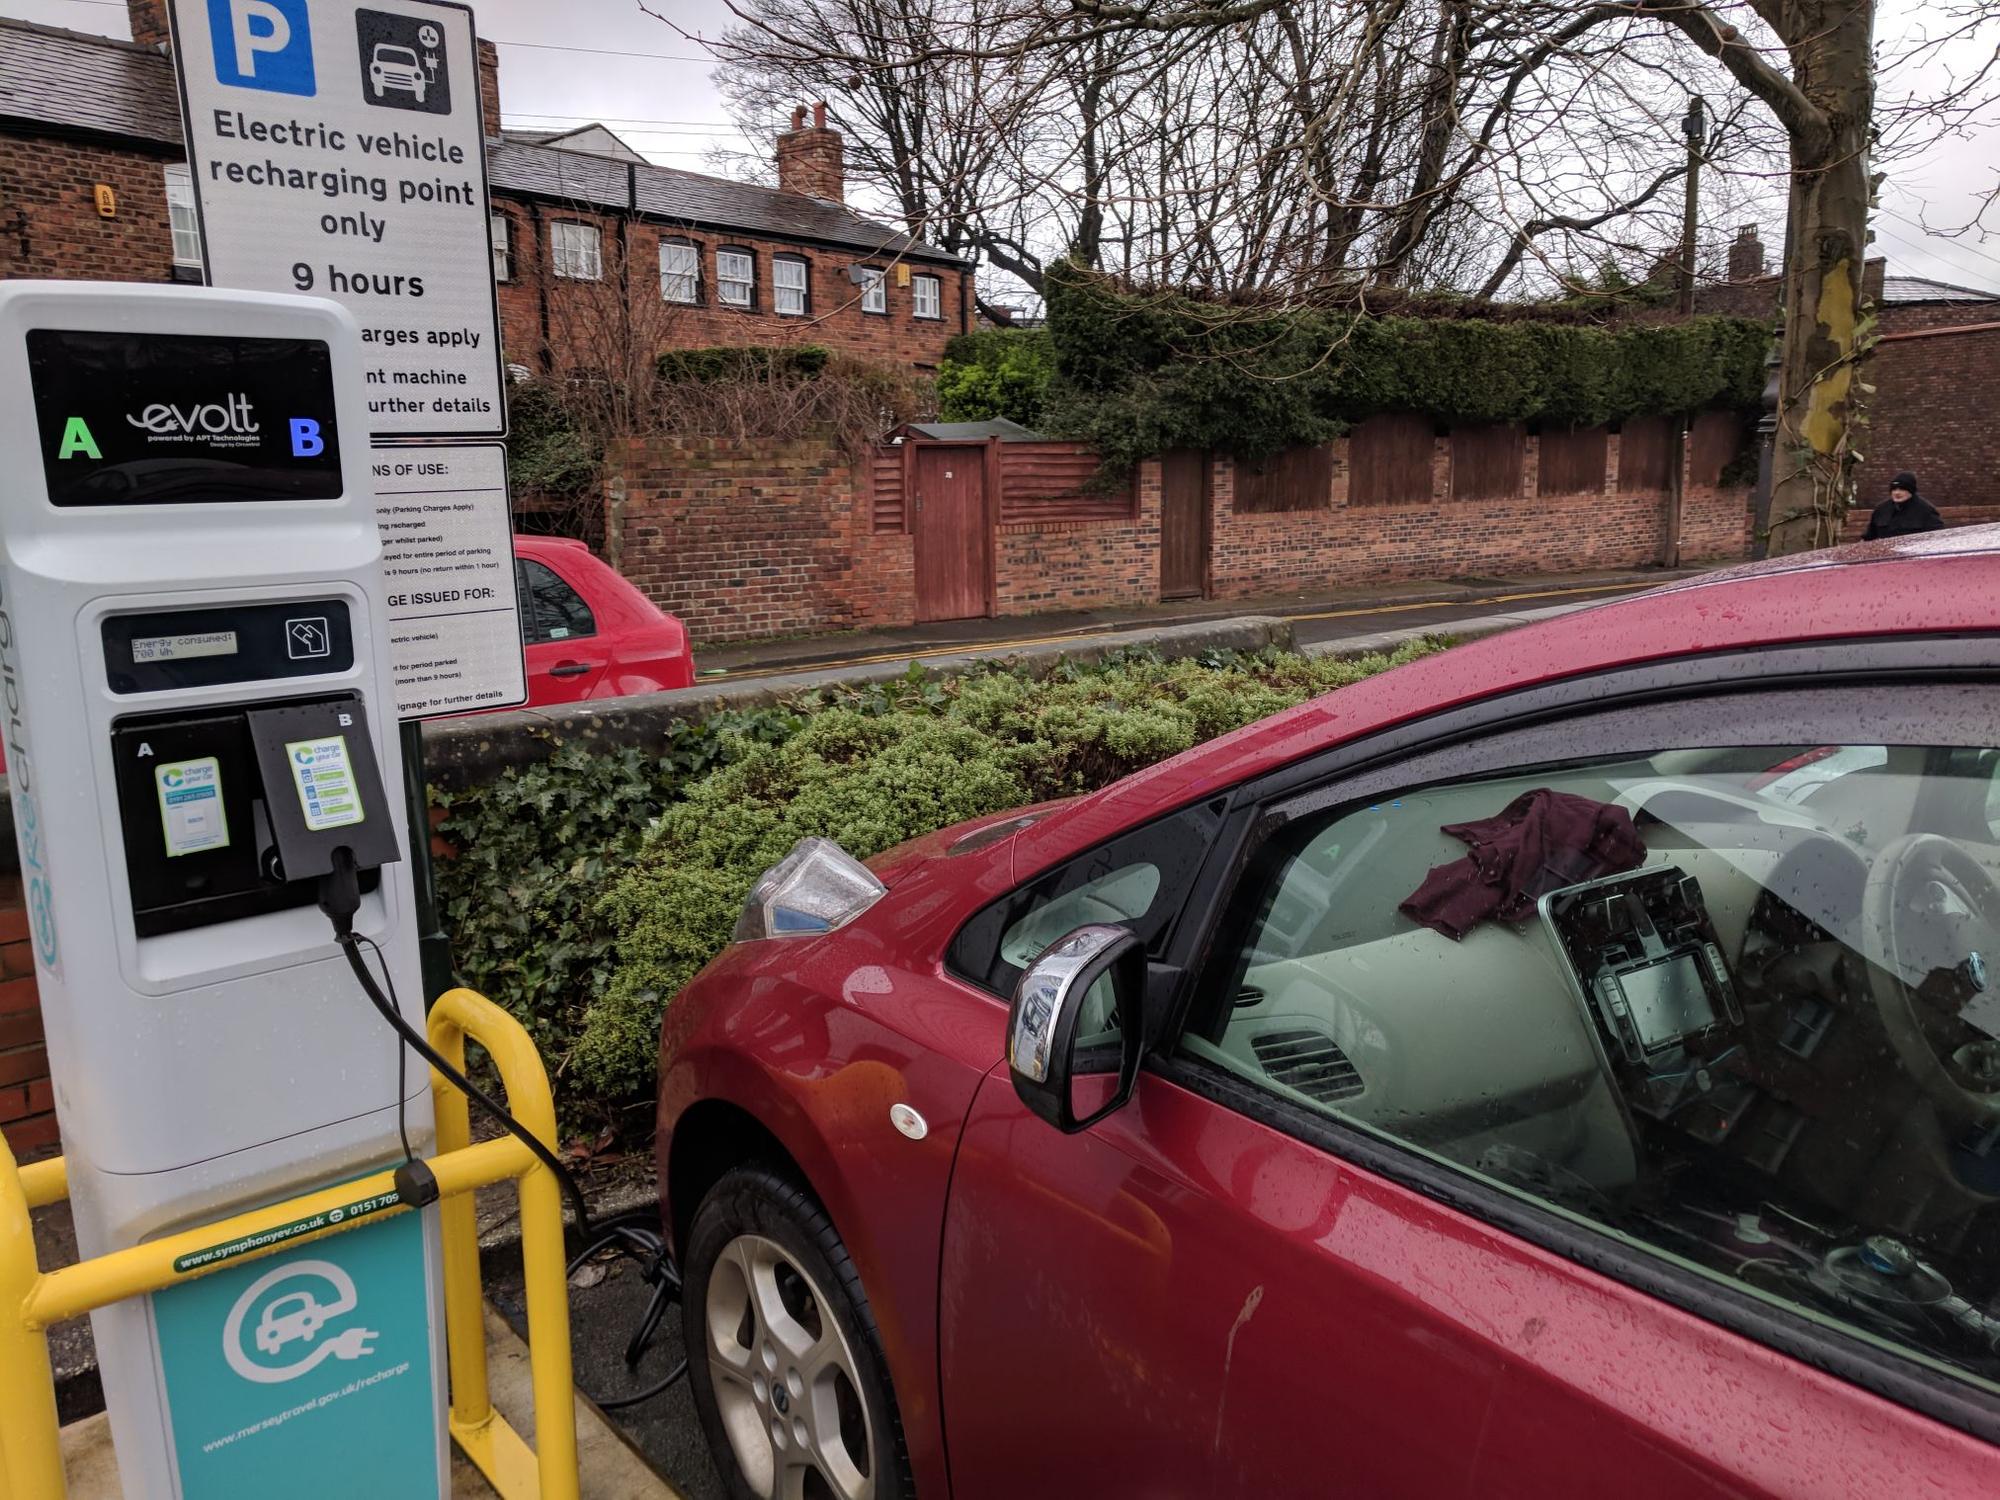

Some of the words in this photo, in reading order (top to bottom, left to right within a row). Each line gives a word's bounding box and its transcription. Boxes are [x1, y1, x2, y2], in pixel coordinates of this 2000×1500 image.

[230, 0, 290, 77] P
[213, 109, 345, 151] Electric
[357, 130, 464, 164] vehicle
[210, 158, 387, 202] recharging
[400, 180, 474, 206] point
[320, 211, 386, 243] only
[292, 262, 314, 291] 9
[329, 264, 424, 297] hours
[361, 328, 419, 346] arges
[427, 328, 481, 349] apply
[366, 368, 386, 384] nt
[393, 369, 467, 385] machine
[126, 392, 260, 433] evolt
[368, 397, 425, 413] urther
[432, 397, 491, 414] details
[58, 416, 103, 459] A
[289, 418, 324, 457] B
[147, 434, 182, 442] powered
[184, 434, 194, 442] by
[212, 434, 260, 442] Technologies
[372, 465, 391, 476] NS
[394, 464, 413, 476] OF
[418, 464, 449, 475] USE:
[392, 505, 422, 515] (Parking
[423, 504, 451, 513] Charges
[452, 504, 474, 512] Apply)
[391, 520, 426, 530] recharged
[395, 536, 416, 544] whilst
[418, 535, 443, 544] parked)
[402, 552, 413, 560] for
[414, 551, 434, 560] entire
[435, 549, 457, 559] period
[458, 548, 466, 556] of
[466, 548, 492, 557] parking
[398, 566, 419, 576] hours
[433, 564, 454, 573] return
[454, 563, 474, 572] within
[482, 562, 500, 570] hour)
[388, 595, 408, 607] GE
[411, 590, 460, 605] ISSUED
[464, 588, 495, 600] FOR:
[133, 638, 172, 650] Energy
[411, 632, 438, 642] vehicle)
[410, 662, 433, 672] period
[434, 658, 458, 668] parked
[439, 672, 462, 681] hours)
[430, 698, 442, 706] for
[444, 694, 473, 705] further
[475, 690, 503, 701] details
[338, 714, 352, 726] B
[137, 743, 154, 758] A
[314, 744, 340, 756] charge
[184, 765, 213, 776] charge
[180, 1216, 324, 1269] www.symphonyev.co.uk
[350, 1199, 378, 1215] 0151
[379, 1192, 400, 1207] 709
[202, 1361, 410, 1454] www.merseytravel.gov.uk/recharge
